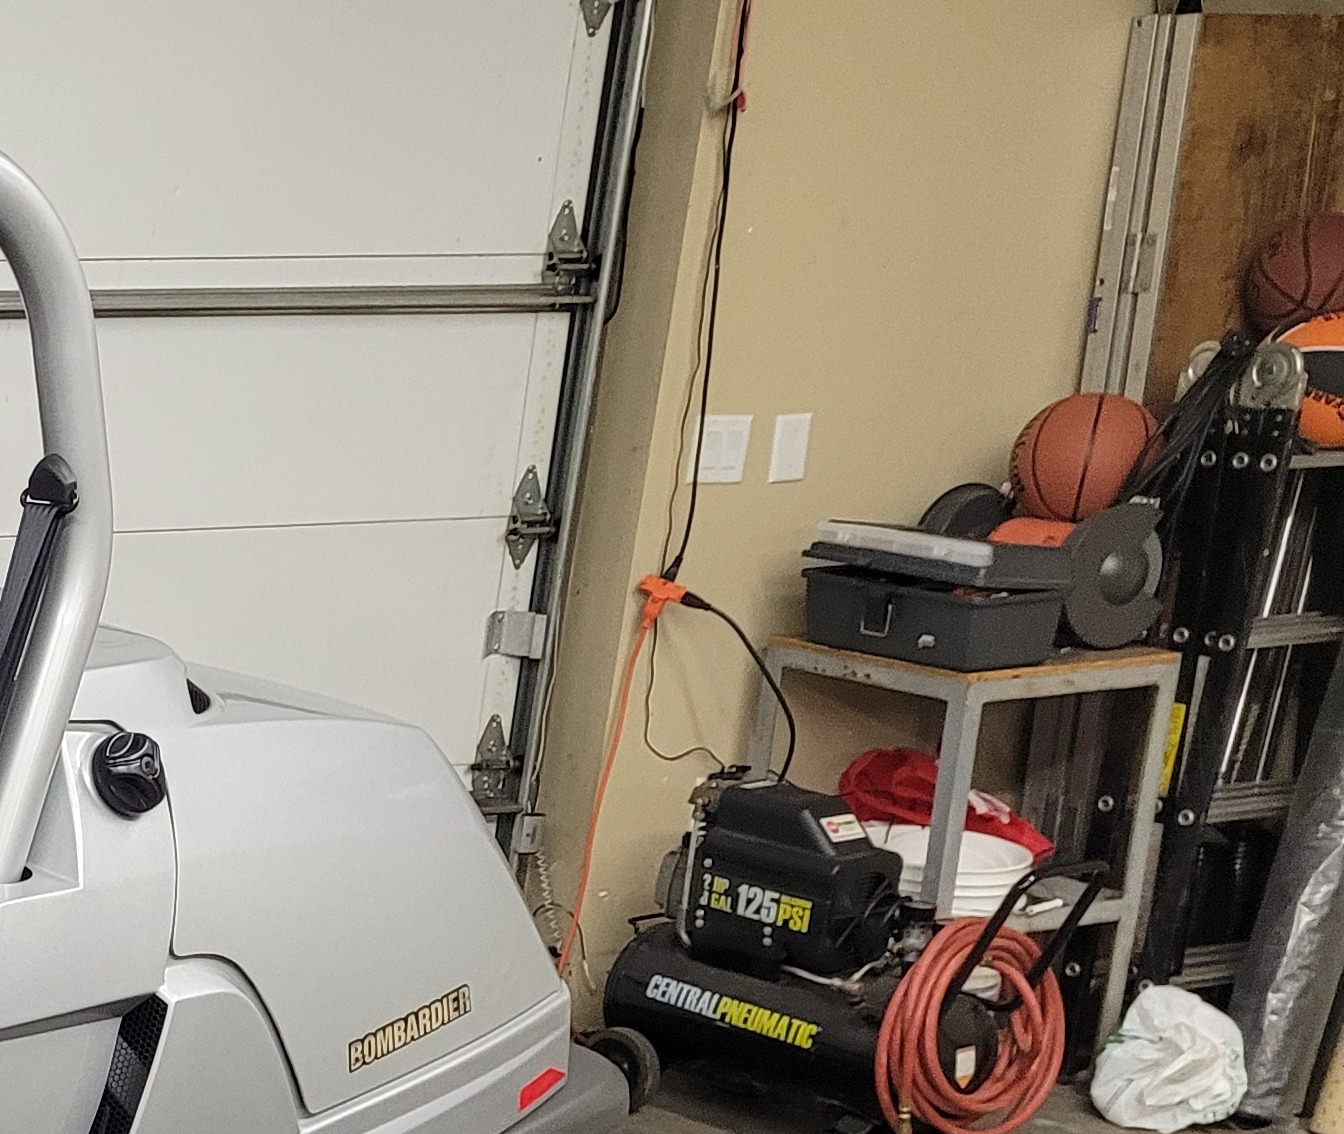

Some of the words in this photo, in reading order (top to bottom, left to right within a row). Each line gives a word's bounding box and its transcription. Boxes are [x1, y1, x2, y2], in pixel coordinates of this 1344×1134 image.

[736, 883, 780, 924] 125
[776, 903, 811, 933] PSI
[350, 985, 470, 1071] BOMBARDIER
